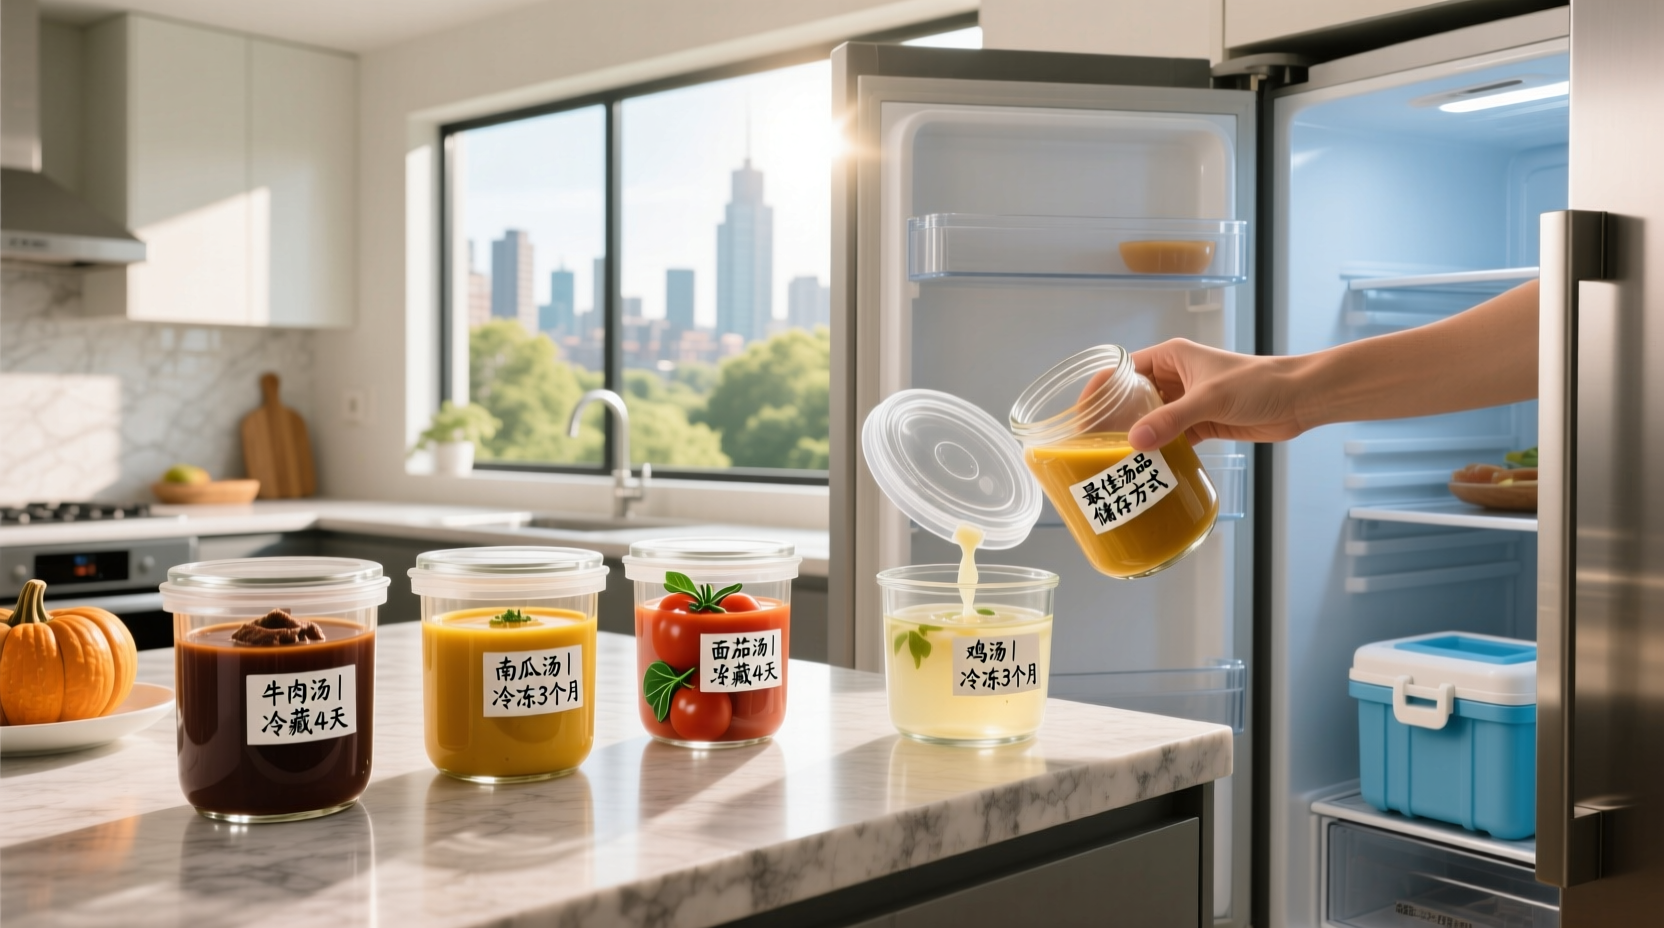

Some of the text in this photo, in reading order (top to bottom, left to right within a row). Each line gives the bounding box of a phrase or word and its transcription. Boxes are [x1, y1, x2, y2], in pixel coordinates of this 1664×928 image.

[1081, 452, 1153, 507] 最佳汤品
[1093, 468, 1169, 527] 储存方式
[959, 662, 1037, 690] 冷冻3个月
[492, 679, 579, 710] 冷冻3个月
[261, 706, 349, 737] 冷藏4天
